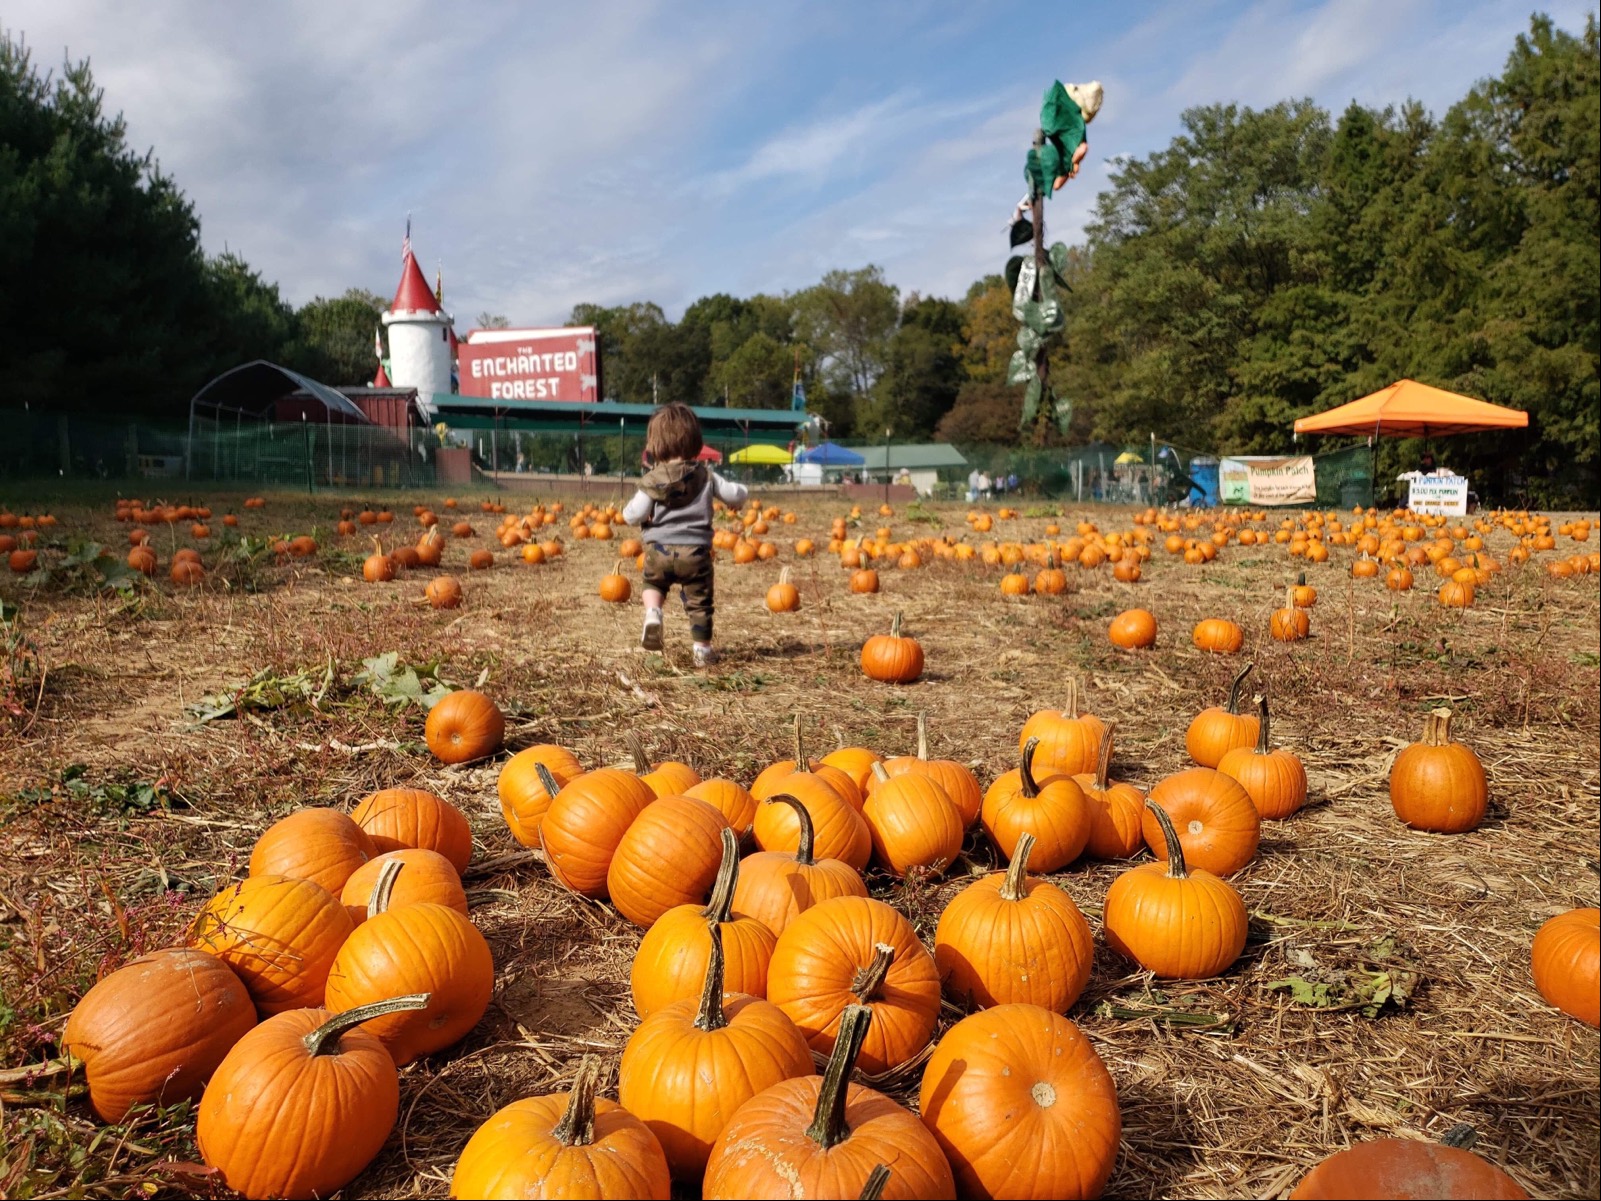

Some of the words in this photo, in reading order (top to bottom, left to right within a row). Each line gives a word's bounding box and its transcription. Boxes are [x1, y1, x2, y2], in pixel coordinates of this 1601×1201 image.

[517, 346, 533, 354] THE
[471, 351, 577, 378] ENCHANTED
[491, 377, 560, 399] FOREST
[1250, 466, 1283, 477] Pumpkin
[1285, 465, 1309, 475] Patch
